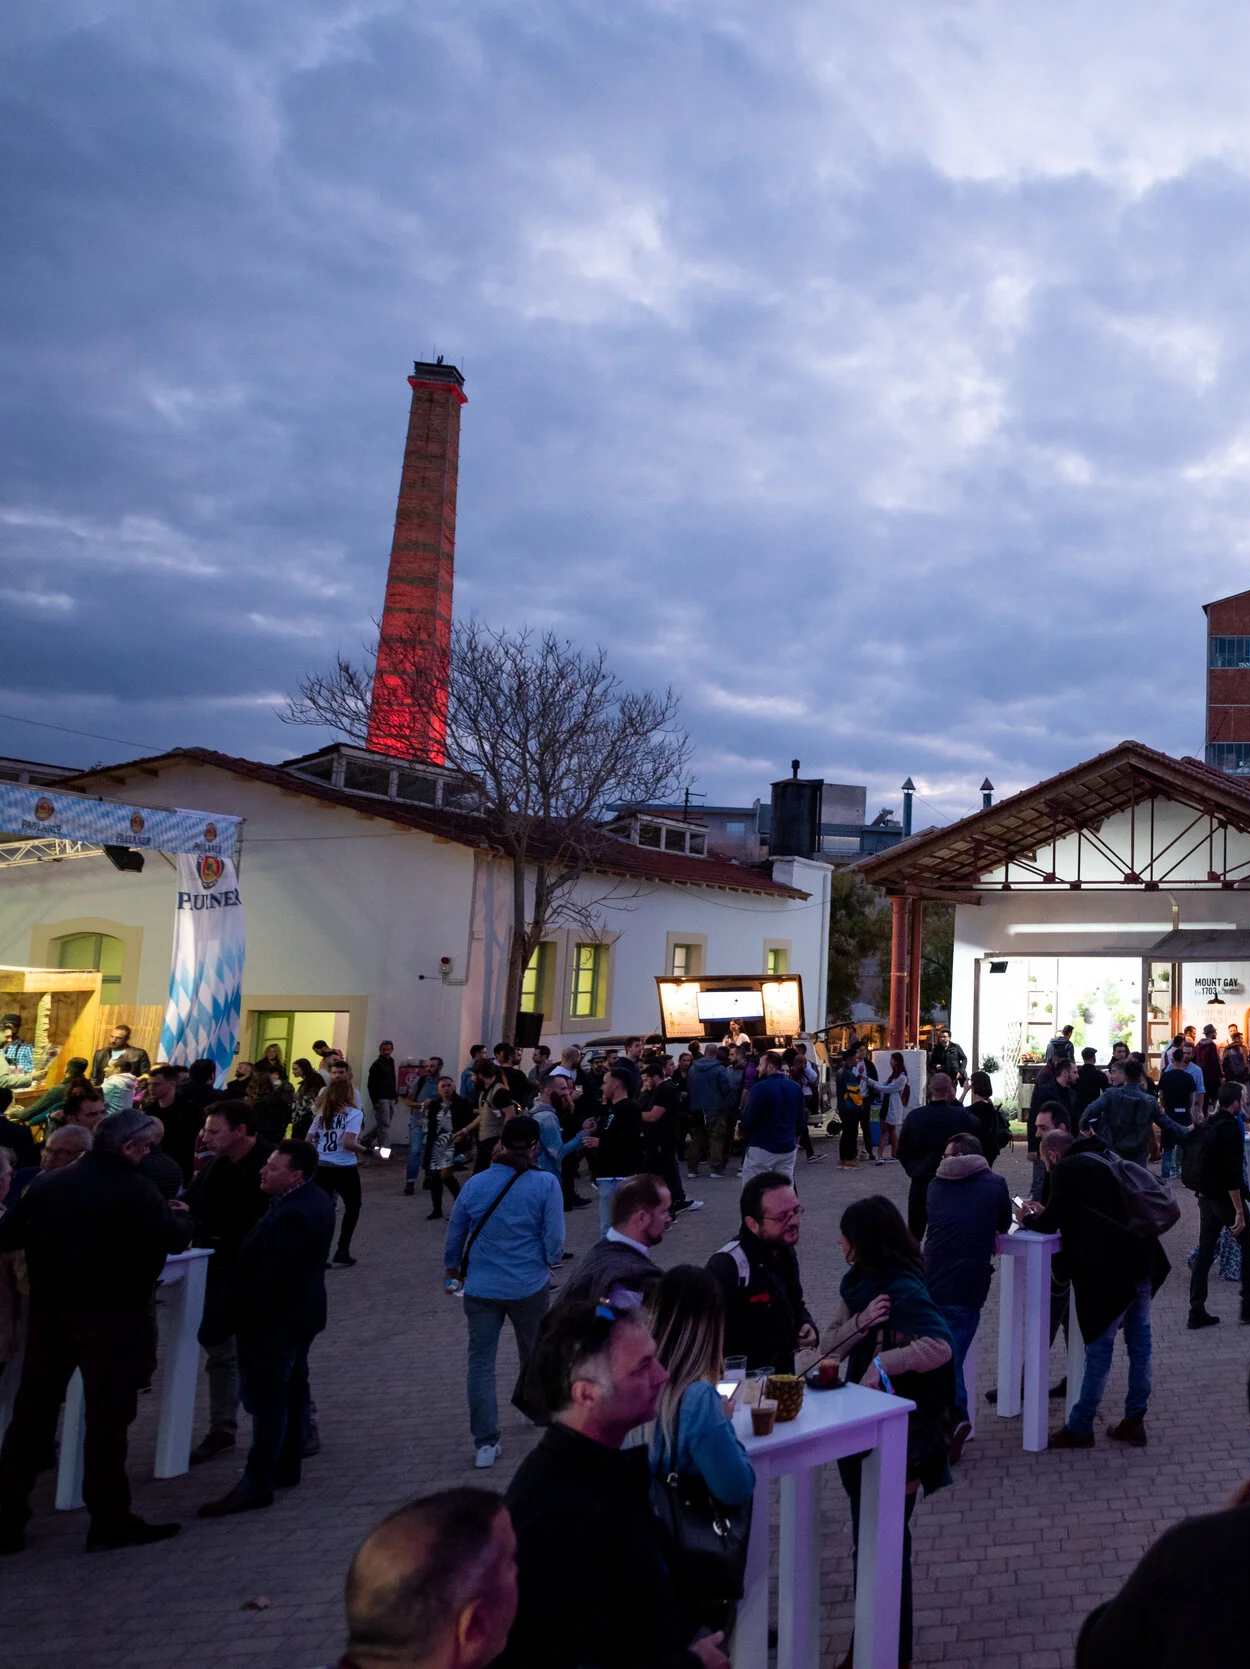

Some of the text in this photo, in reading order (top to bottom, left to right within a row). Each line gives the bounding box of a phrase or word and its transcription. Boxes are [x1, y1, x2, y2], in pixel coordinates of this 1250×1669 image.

[1195, 978, 1238, 987] MOUNT GAY
[1202, 987, 1217, 995] 1703
[323, 1131, 338, 1152] 18
